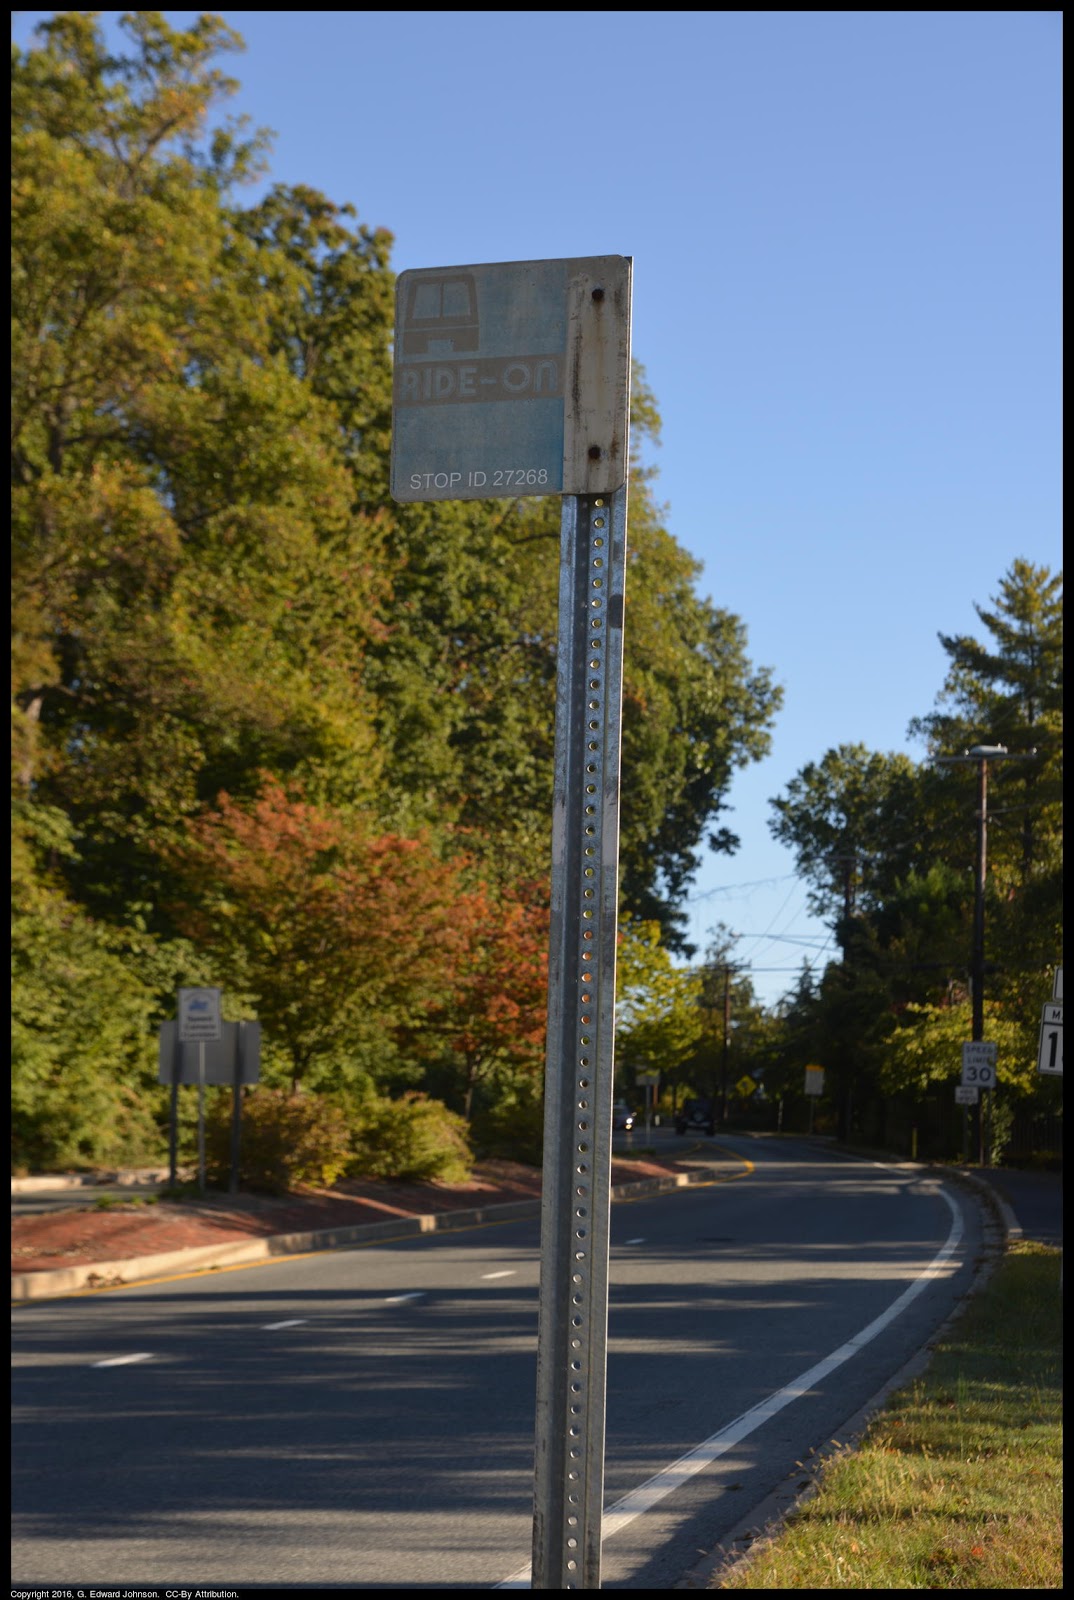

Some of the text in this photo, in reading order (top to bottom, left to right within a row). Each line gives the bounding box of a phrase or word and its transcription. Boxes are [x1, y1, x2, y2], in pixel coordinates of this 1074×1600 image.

[410, 468, 548, 490] STOP ID 27268
[965, 1045, 994, 1054] SPEED
[966, 1066, 991, 1082] 30
